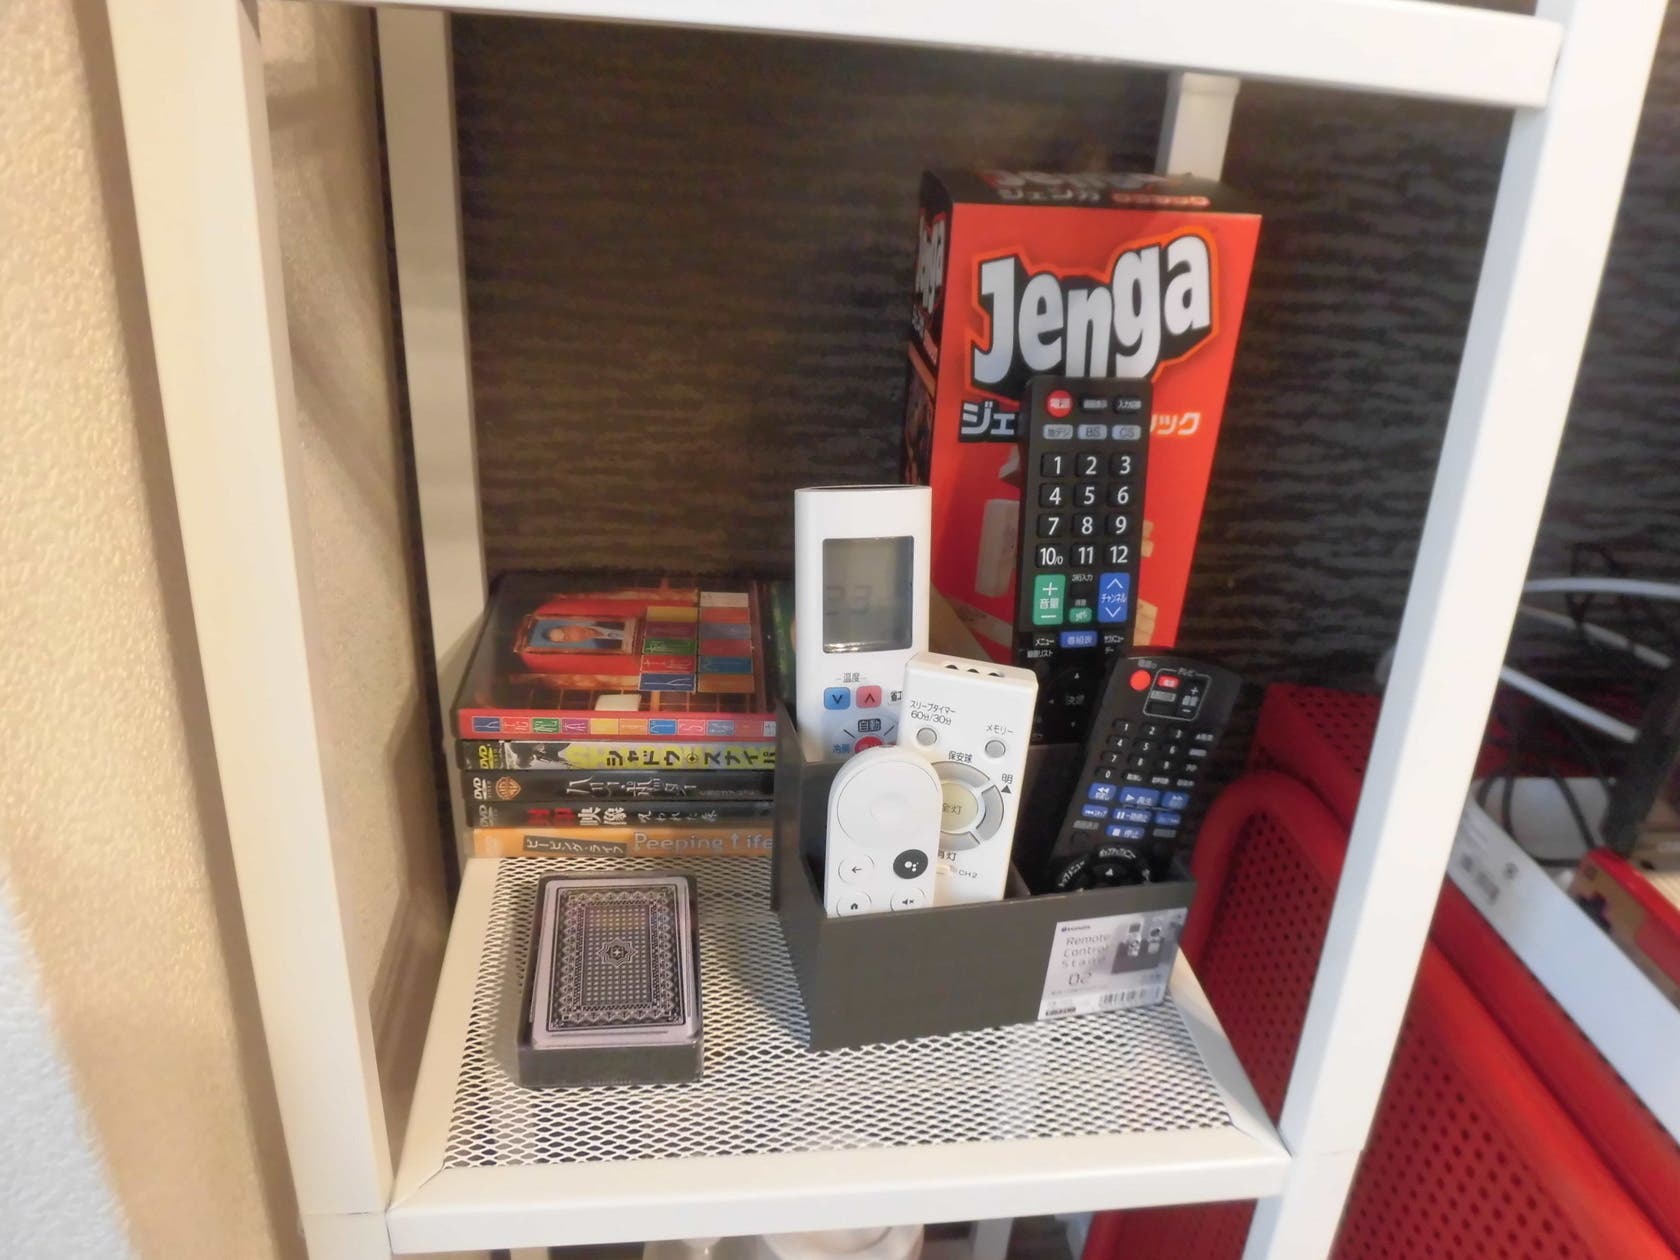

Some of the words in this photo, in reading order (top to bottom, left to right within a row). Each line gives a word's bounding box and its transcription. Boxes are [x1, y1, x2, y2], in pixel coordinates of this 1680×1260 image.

[973, 235, 1210, 385] Jenga
[961, 401, 1015, 435] ジェ
[1085, 427, 1099, 437] BS
[1119, 427, 1135, 437] CS
[1054, 456, 1062, 475] 1
[1085, 456, 1097, 475] 2
[1119, 456, 1131, 474] 3
[1049, 487, 1061, 505] 4
[1083, 486, 1095, 505] 5
[1117, 486, 1129, 504] 6
[1048, 517, 1059, 536] 7
[1081, 516, 1093, 535] 8
[1115, 516, 1127, 534] 9
[1078, 546, 1094, 564] 11
[1110, 545, 1128, 563] 12
[1040, 598, 1060, 609] 音量
[1101, 593, 1127, 604] チャンネル
[843, 672, 861, 683] 温度
[911, 701, 956, 714] スリープタイマー
[986, 724, 1014, 735] メモリー
[1124, 723, 1129, 731] 1
[1149, 727, 1155, 735] 2
[1176, 730, 1182, 738] 3
[1117, 739, 1123, 747] 4
[1143, 743, 1149, 751] 5
[1169, 746, 1175, 754] 6
[948, 750, 973, 764] 保安球
[1111, 755, 1117, 763] 7
[1138, 758, 1144, 766] 8
[1164, 761, 1170, 770] 9
[1001, 773, 1014, 785] 明
[1105, 770, 1111, 778] 0
[473, 777, 482, 800] DVD
[634, 832, 722, 852] Peeping
[959, 868, 978, 878] CH2
